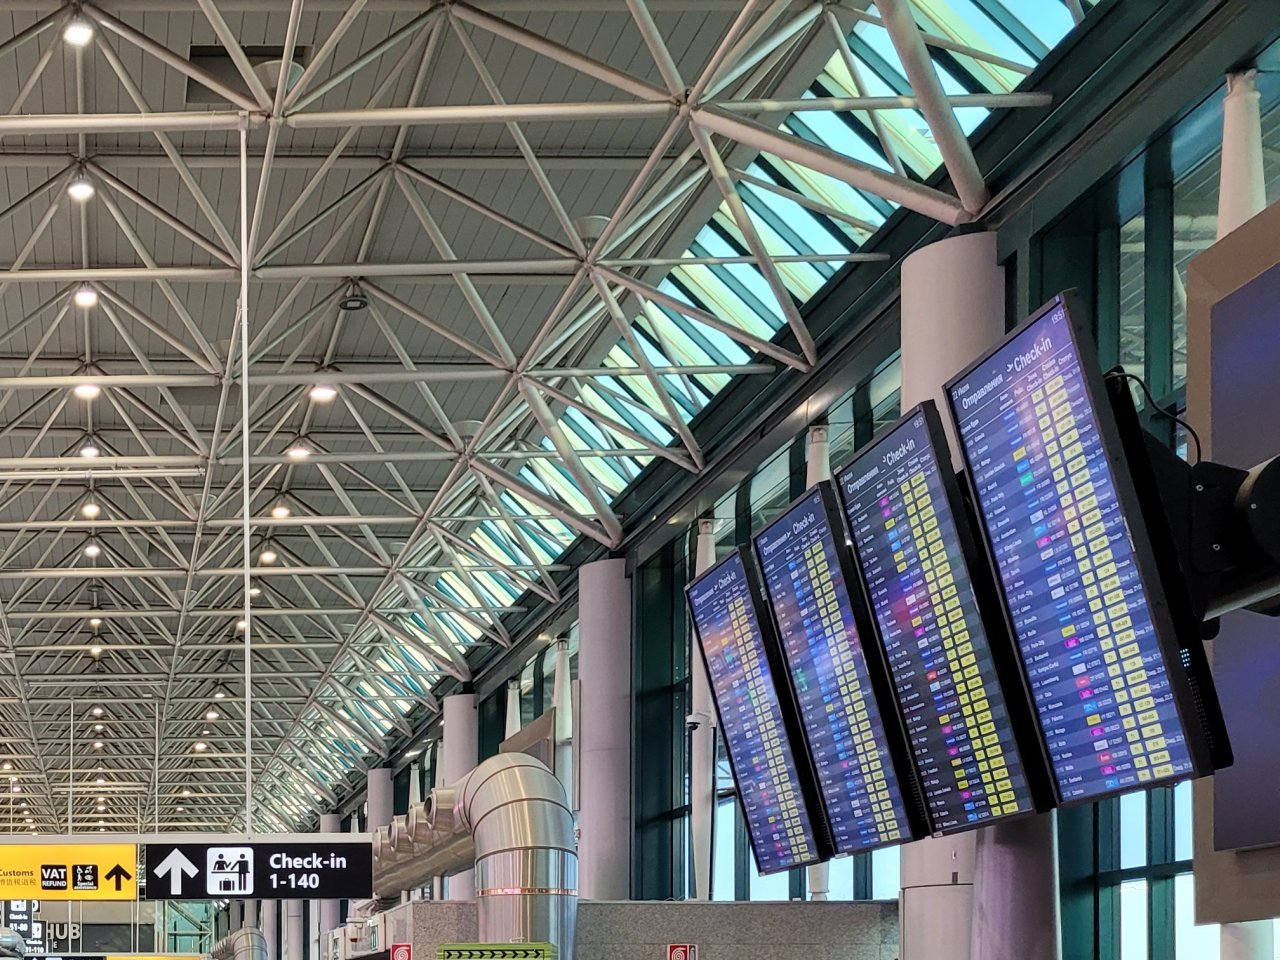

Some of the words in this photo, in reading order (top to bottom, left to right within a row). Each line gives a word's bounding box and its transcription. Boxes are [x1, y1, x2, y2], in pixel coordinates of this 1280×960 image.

[1014, 338, 1053, 372] Check-in
[886, 439, 916, 466] Check-in
[269, 853, 346, 870] Check-in
[42, 868, 66, 879] VAT
[270, 873, 320, 888] 1-140
[46, 924, 80, 939] HUB
